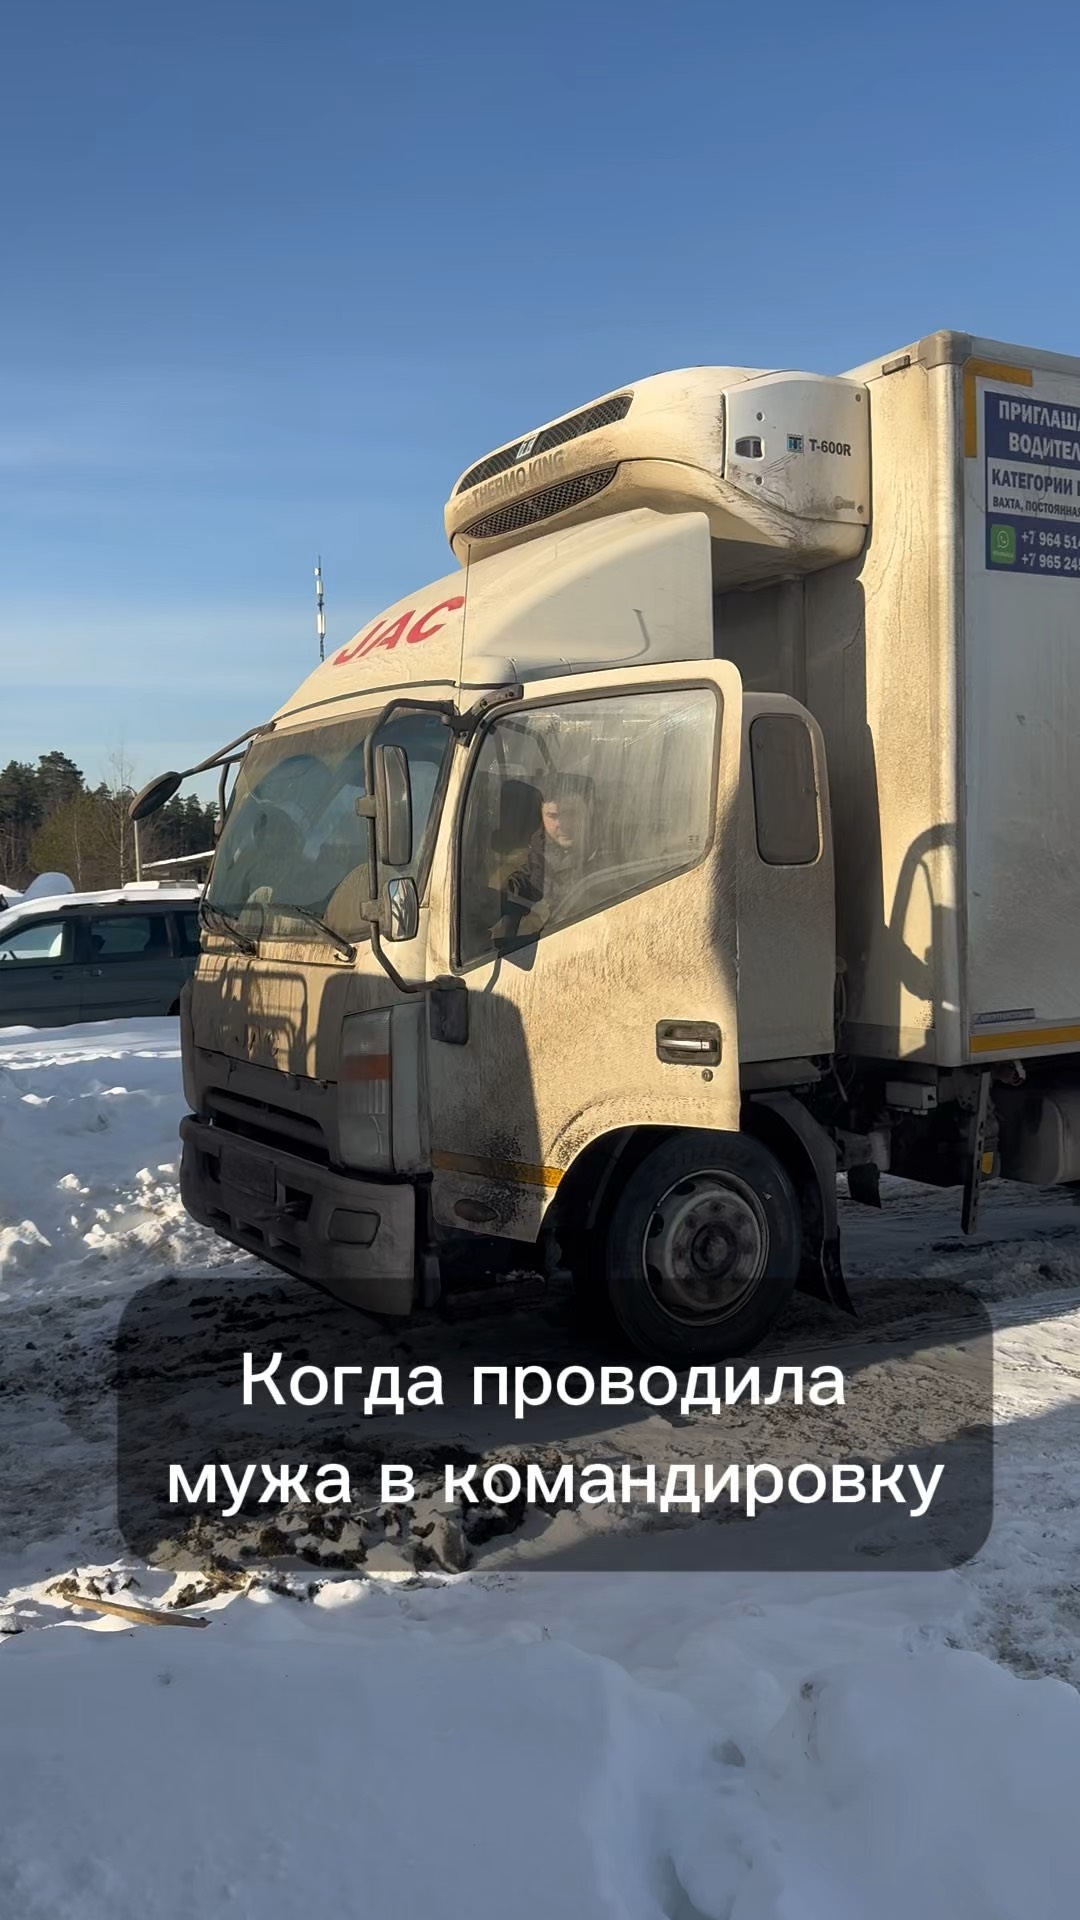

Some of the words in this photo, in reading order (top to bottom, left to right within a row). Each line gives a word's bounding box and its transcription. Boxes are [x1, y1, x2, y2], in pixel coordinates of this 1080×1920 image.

[999, 400, 1080, 432] ПРИГЛАШ
[808, 438, 851, 456] T-600R
[472, 466, 525, 508] THERMO
[529, 449, 565, 482] KING
[992, 468, 1072, 495] КАТЕГОРИИ
[993, 496, 1024, 512] ВАХТА,
[1021, 531, 1036, 545] +7
[1039, 532, 1061, 548] 964
[1021, 553, 1036, 566] +7
[1039, 554, 1061, 569] 965
[333, 596, 465, 665] JAC
